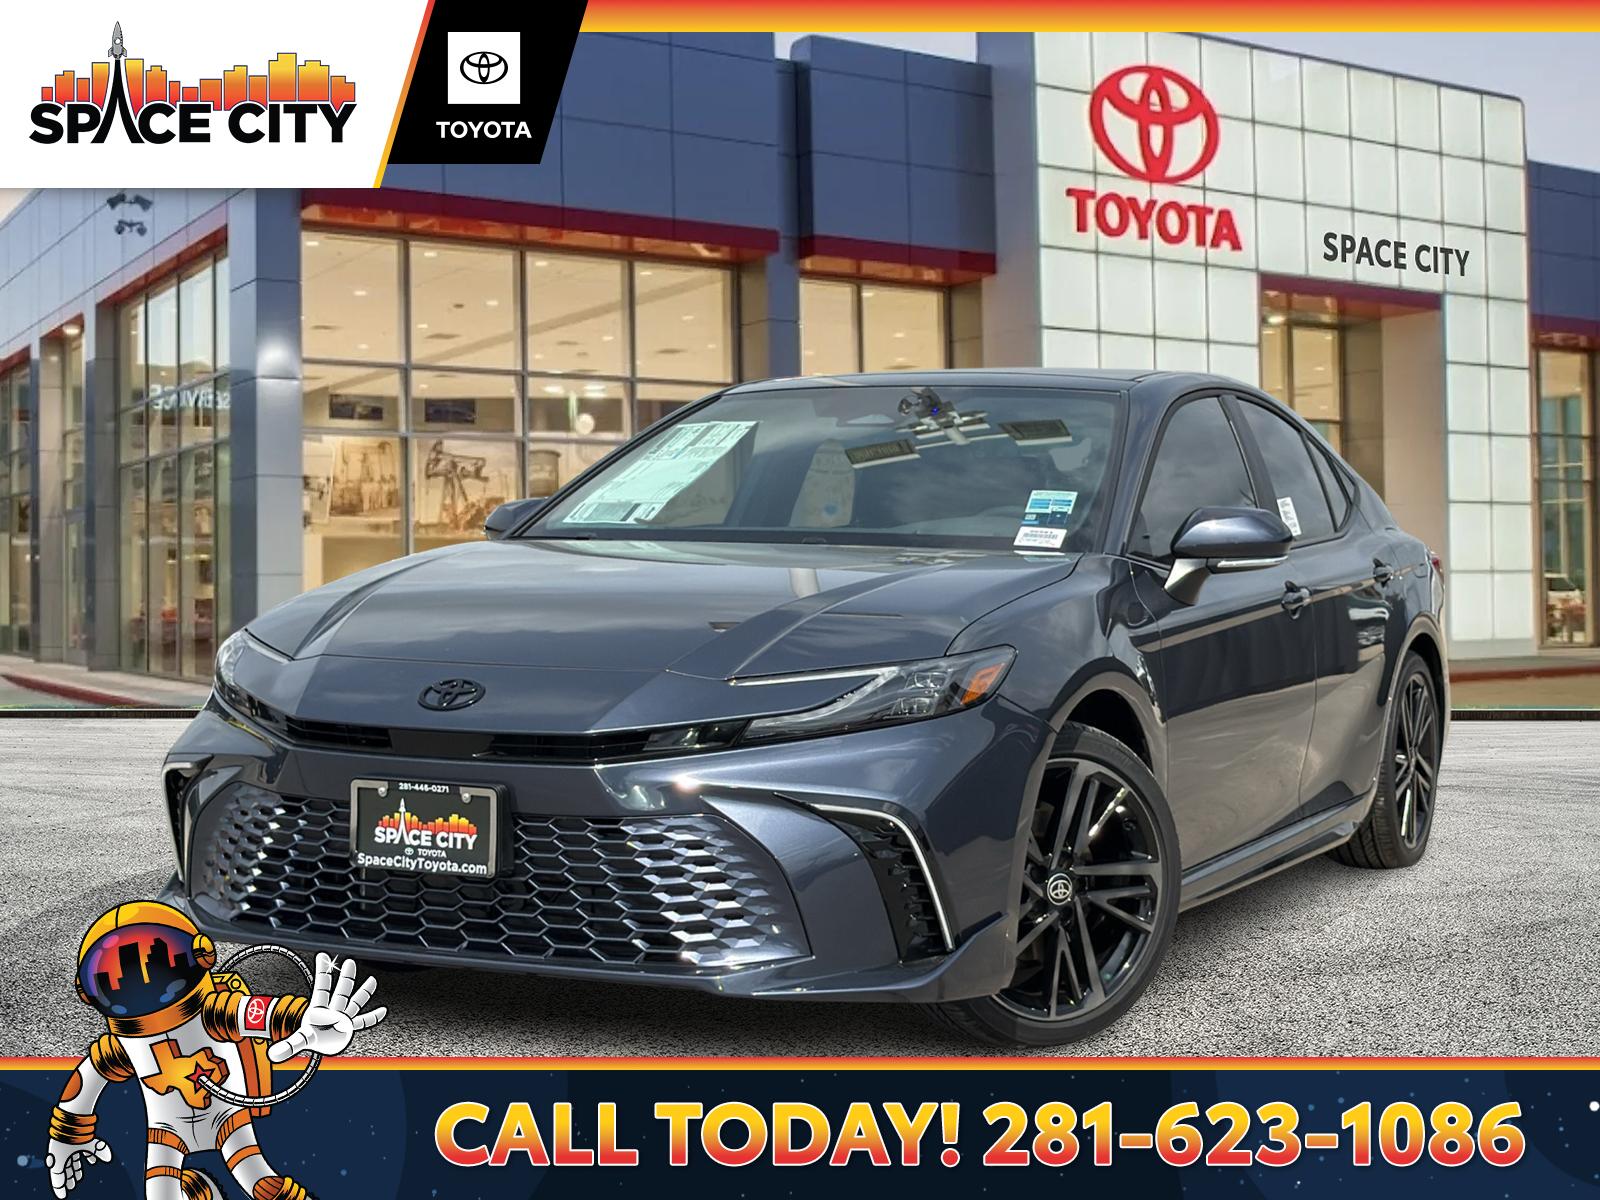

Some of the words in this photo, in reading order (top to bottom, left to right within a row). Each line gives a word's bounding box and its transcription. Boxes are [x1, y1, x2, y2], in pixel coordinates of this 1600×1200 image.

[1066, 187, 1243, 251] TOYOTA
[1322, 231, 1407, 270] SPACE
[1414, 244, 1470, 277] CITY
[417, 847, 447, 858] TOYOTA
[435, 832, 478, 850] CITY
[356, 852, 488, 875] SpaceCityToyota.com
